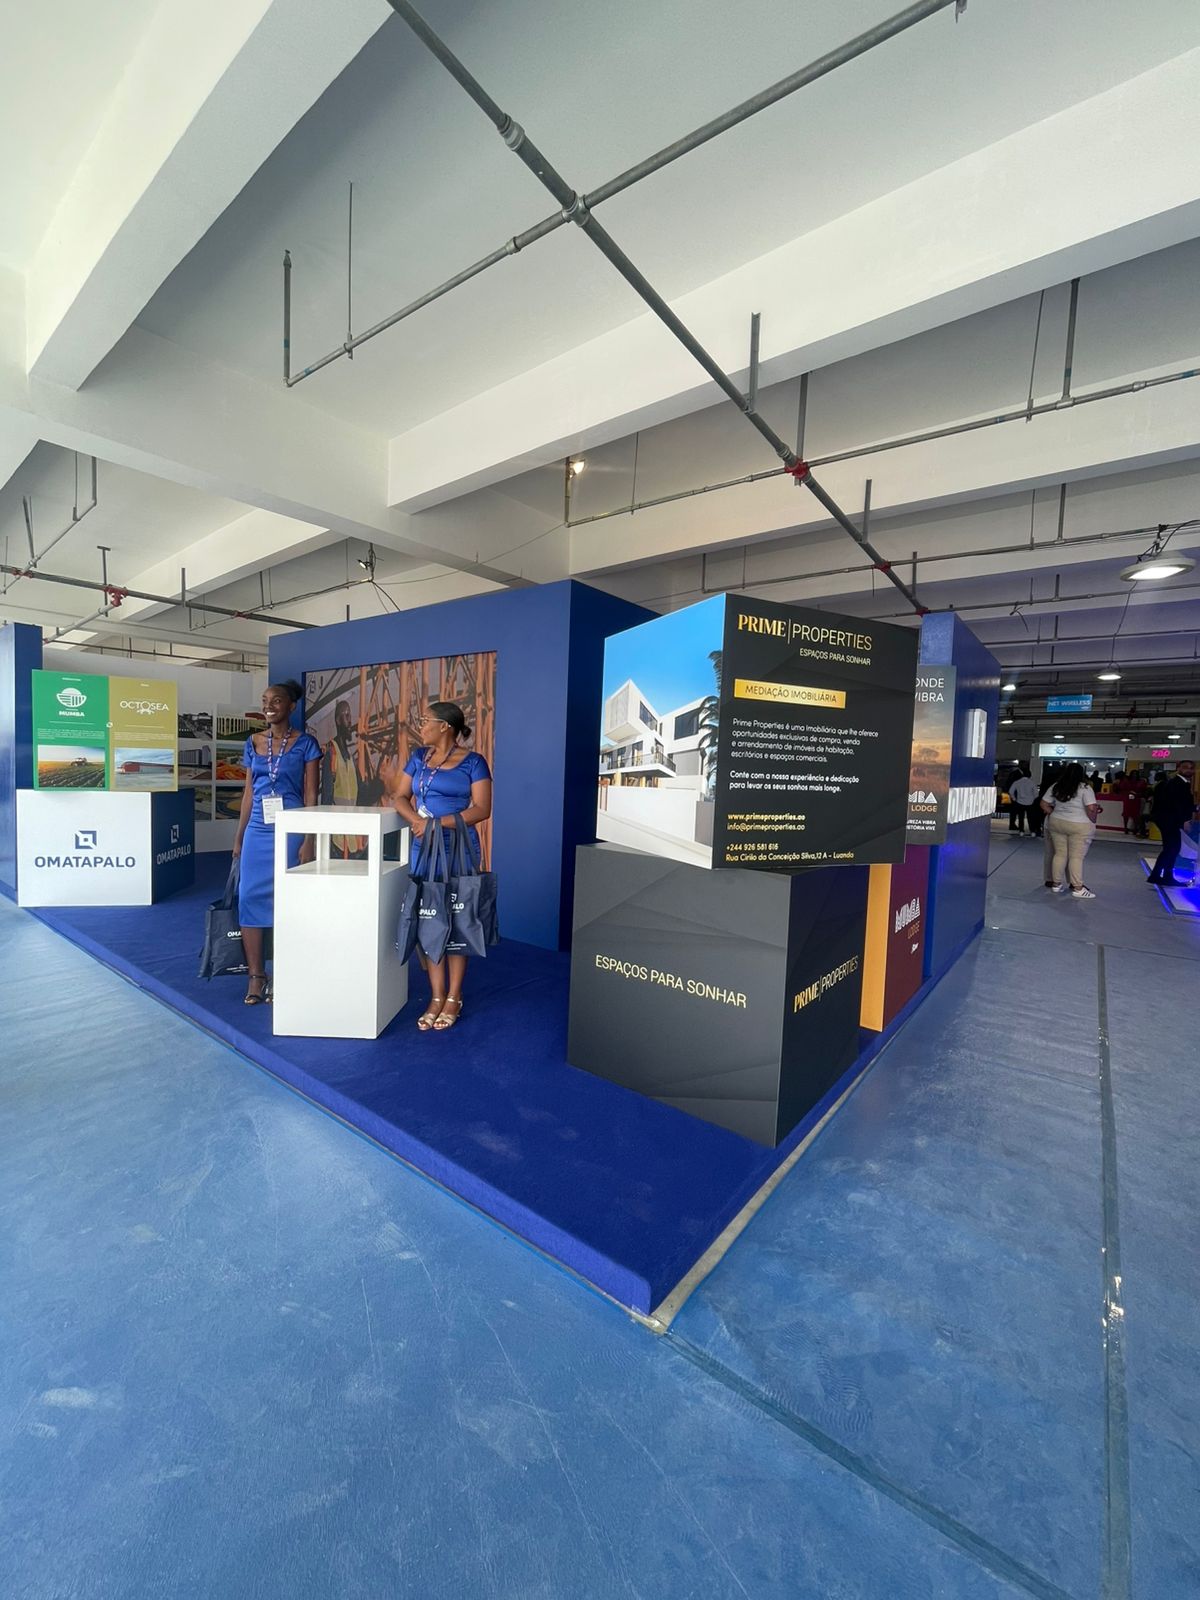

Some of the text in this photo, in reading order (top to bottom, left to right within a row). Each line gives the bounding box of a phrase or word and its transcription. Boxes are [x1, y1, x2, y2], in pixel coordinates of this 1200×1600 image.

[738, 614, 873, 651] PRIME PROPERTIES
[800, 648, 871, 666] ESPAÇOS PARA SONHAR
[745, 685, 838, 703] MEDIAÇÃO IMOBILIÁRIA
[732, 718, 752, 727] Prime
[753, 720, 784, 730] Properties
[732, 730, 778, 740] oportunidades
[779, 732, 808, 742] exclusivas
[843, 738, 860, 746] venda
[737, 740, 784, 750] arrendamento
[784, 742, 792, 750] de
[730, 750, 763, 759] escritórios
[769, 752, 795, 761] espaços
[730, 770, 750, 778] Conte
[790, 774, 824, 782] experiência
[830, 774, 860, 784] dedicação
[729, 782, 746, 790] para
[746, 780, 764, 789] levar
[787, 783, 808, 791] sonhos
[808, 784, 823, 792] mais
[912, 804, 938, 812] LODGE
[156, 844, 192, 864] OMATAPALO
[726, 843, 742, 852] +244
[34, 856, 136, 868] OMATAPALO
[725, 853, 738, 862] Rua
[758, 852, 768, 861] da
[832, 850, 854, 859] Luanda
[596, 954, 746, 1008] ESPAÇOS PARA SONHAR
[794, 955, 858, 1013] PRIME PROPERTIES
